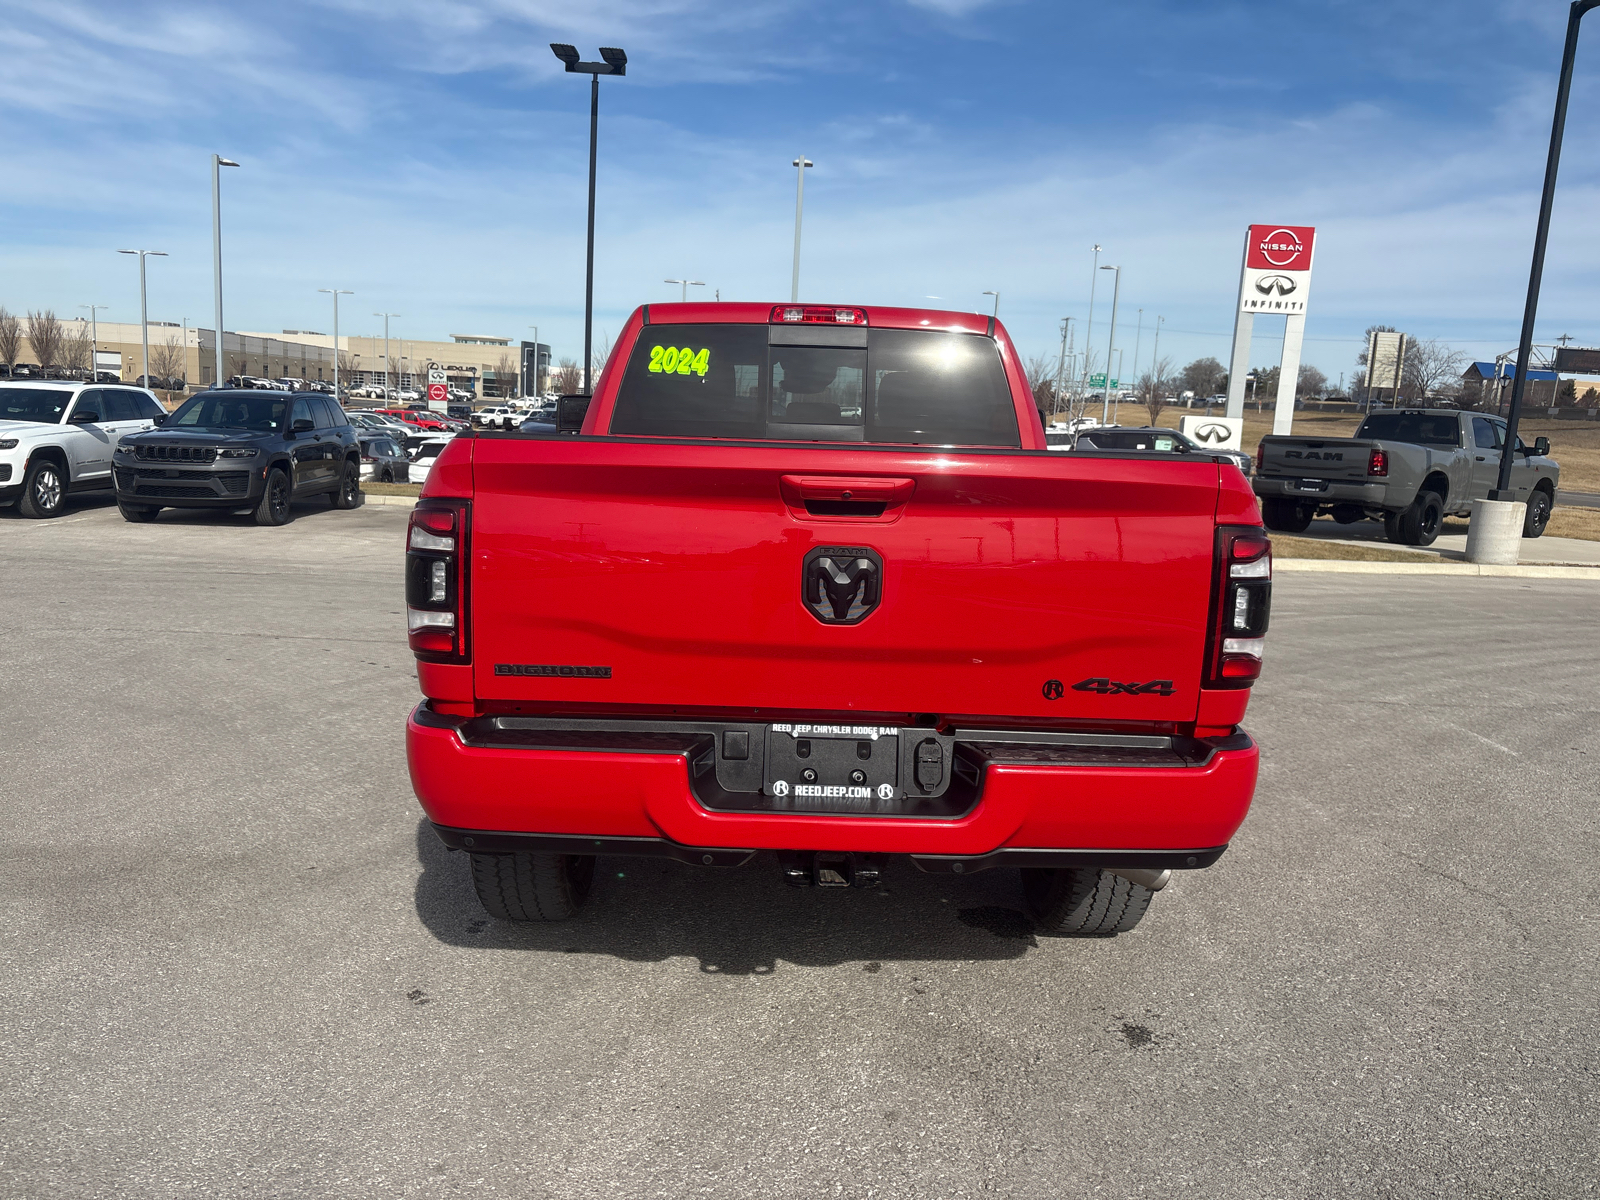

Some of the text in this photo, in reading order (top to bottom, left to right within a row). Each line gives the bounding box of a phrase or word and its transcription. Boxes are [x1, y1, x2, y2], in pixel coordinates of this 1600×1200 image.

[1260, 243, 1303, 251] NISSAN
[1244, 300, 1303, 310] INFINITI
[648, 345, 710, 376] 2024
[1285, 451, 1343, 461] RAM
[820, 548, 867, 556] RAM
[494, 664, 612, 679] BIGHORN
[1071, 677, 1177, 696] 4x4
[772, 724, 898, 735] REED JEEP CHRYSLER DODGE RAM
[795, 785, 871, 798] REEDJEEP.COM
